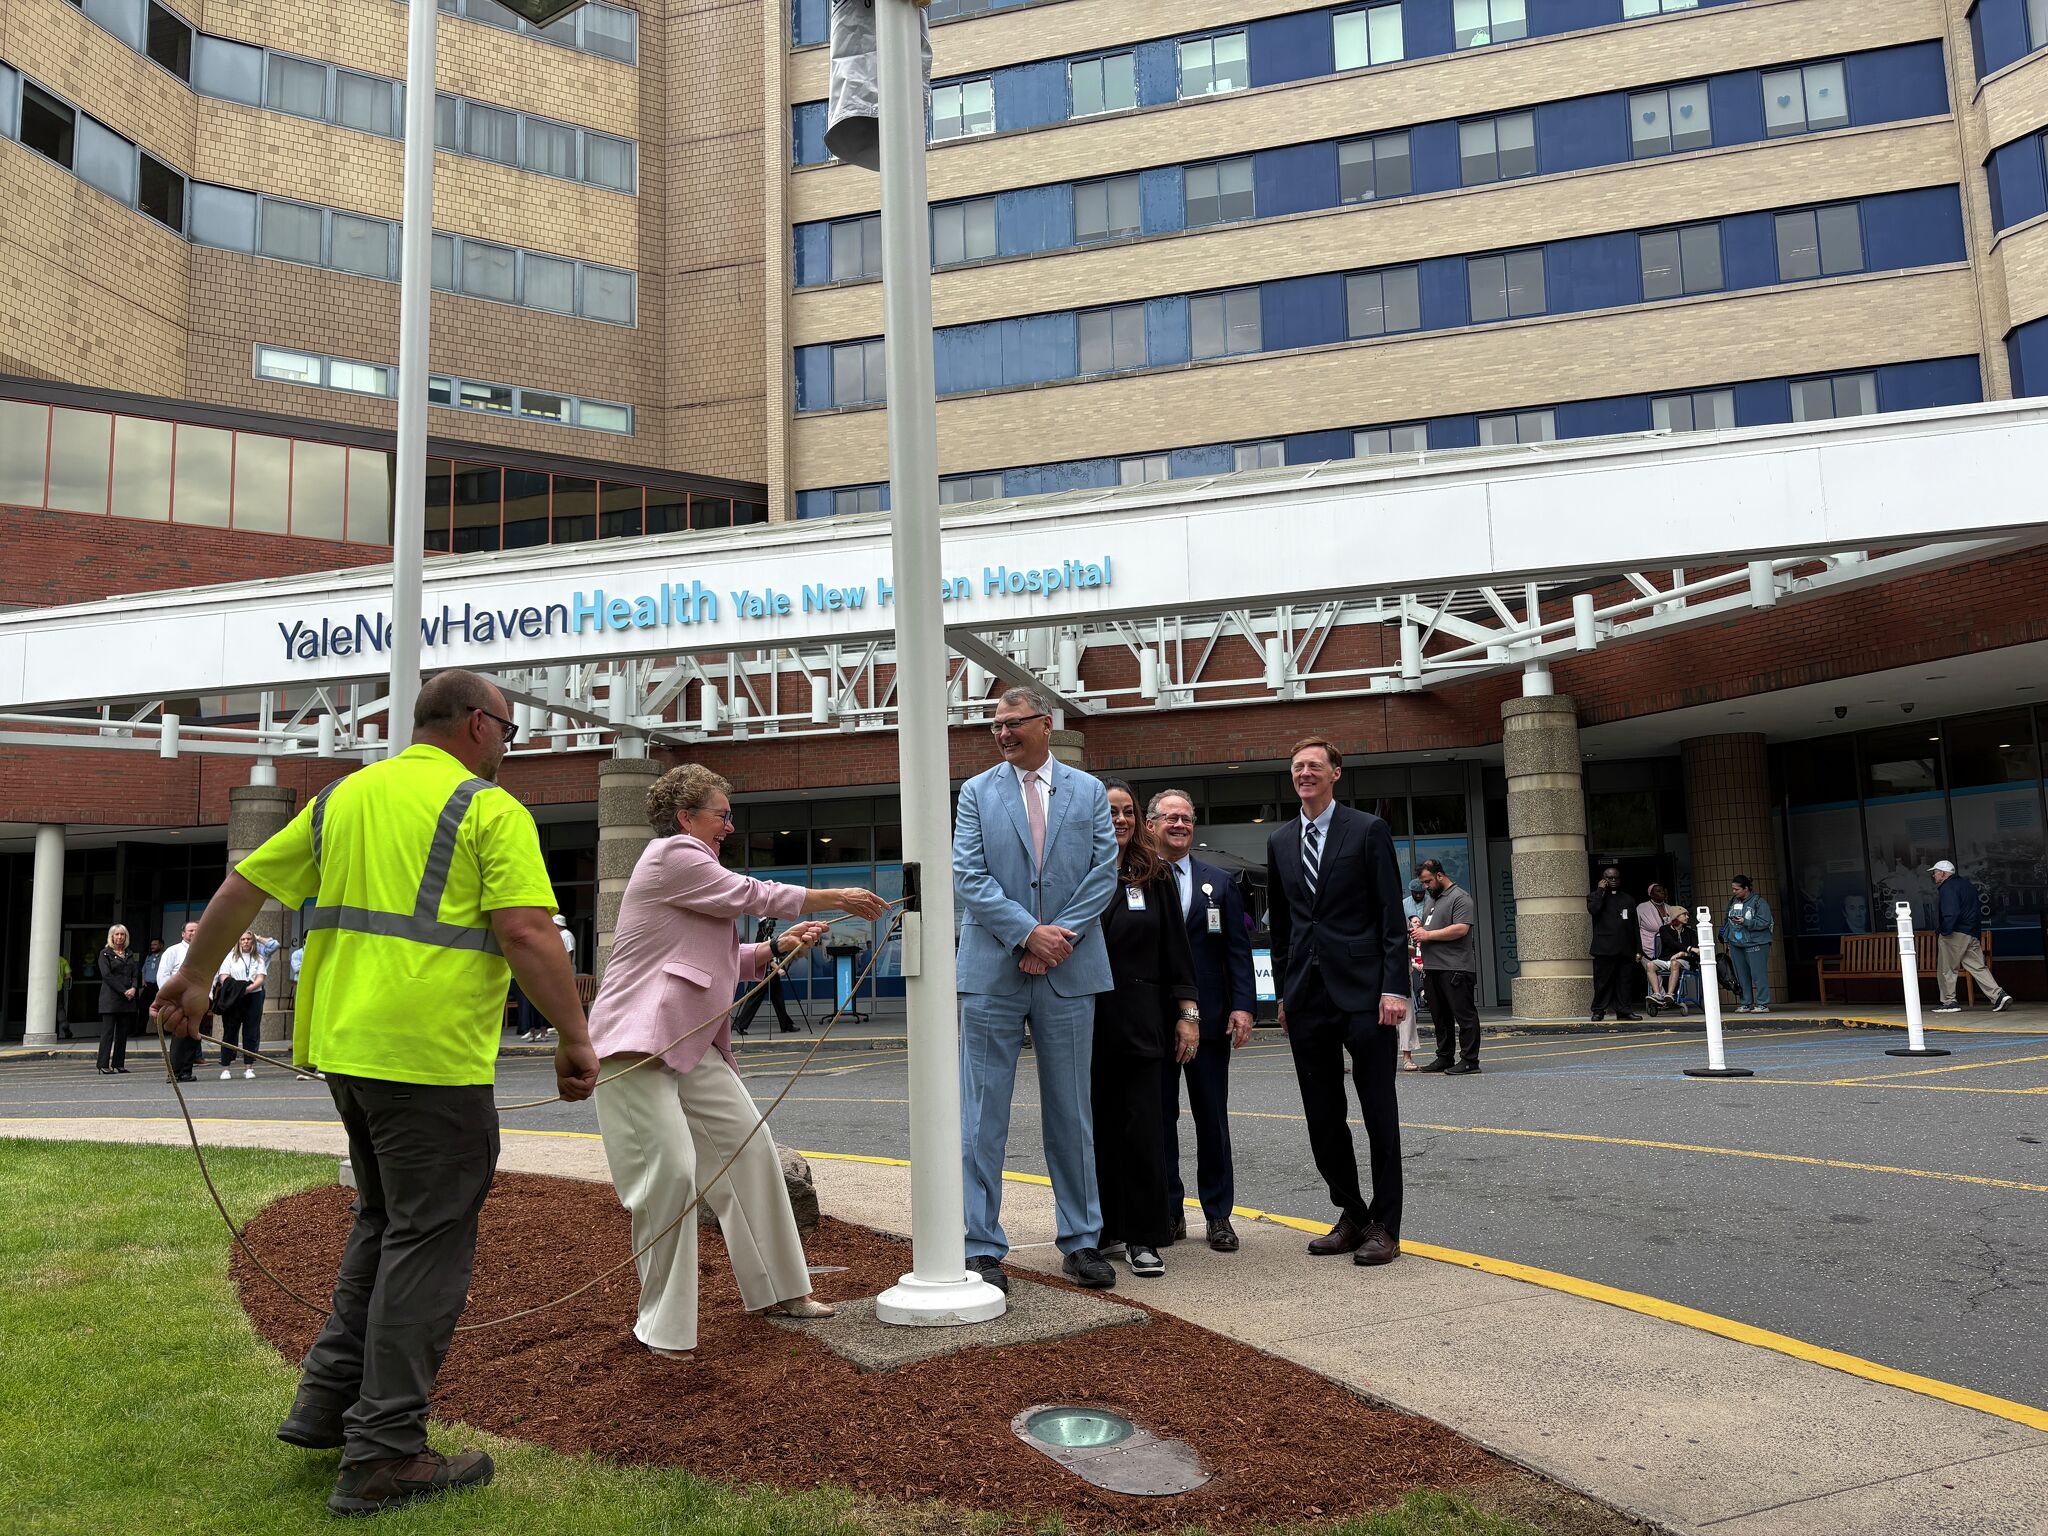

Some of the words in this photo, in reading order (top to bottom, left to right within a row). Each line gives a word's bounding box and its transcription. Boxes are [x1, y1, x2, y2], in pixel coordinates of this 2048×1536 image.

[731, 587, 791, 618] Yale
[802, 582, 866, 612] New
[877, 576, 970, 605] Hen
[983, 556, 1112, 597] Hospital
